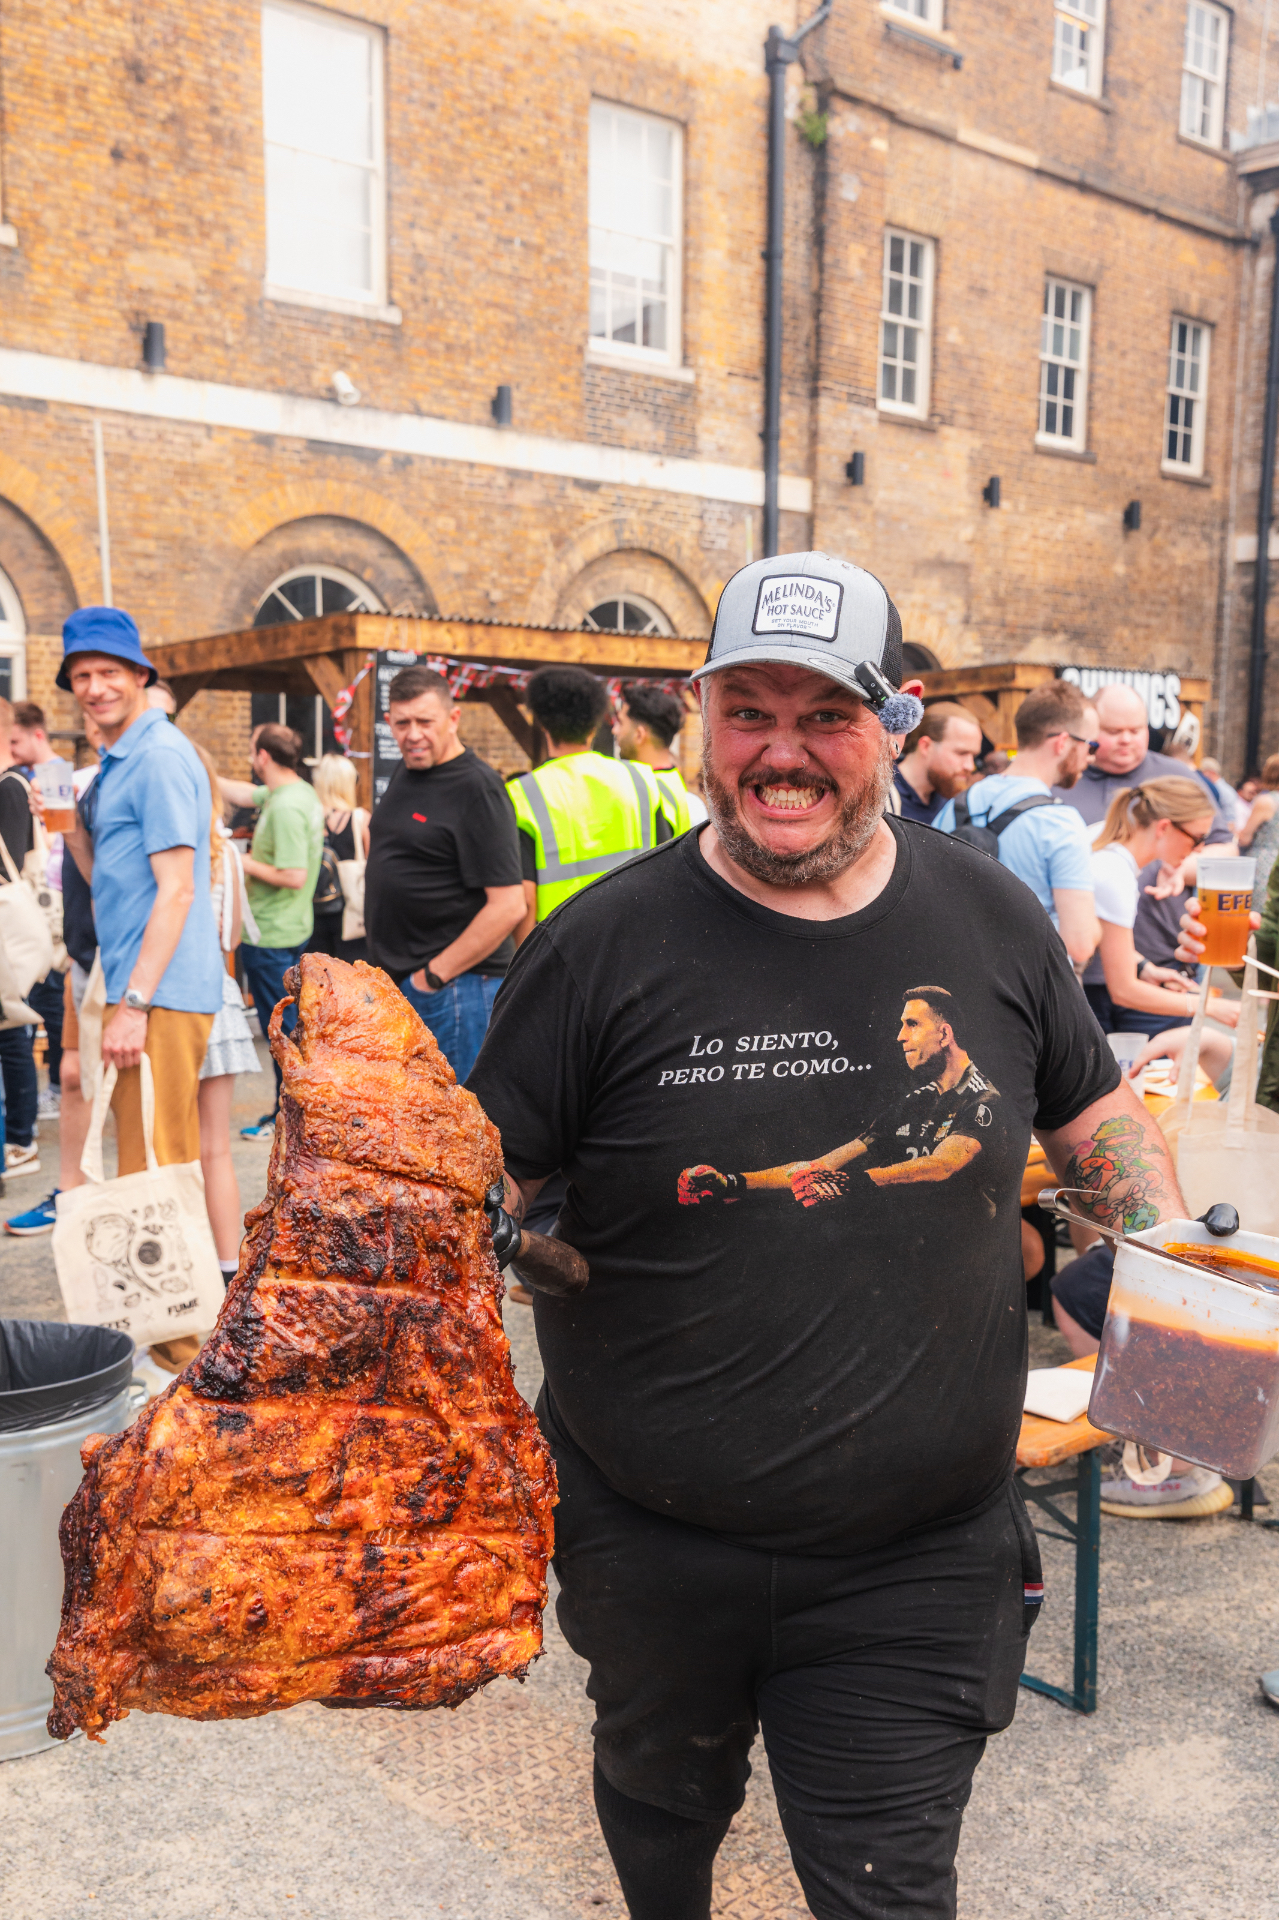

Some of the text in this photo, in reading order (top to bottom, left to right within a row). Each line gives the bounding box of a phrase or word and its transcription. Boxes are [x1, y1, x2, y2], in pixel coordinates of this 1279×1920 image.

[761, 582, 833, 613] MELINDA'S
[767, 604, 825, 620] HOT SAUCE
[735, 1030, 839, 1052] SIENTO,
[657, 1057, 872, 1086] PERO TE COMO...
